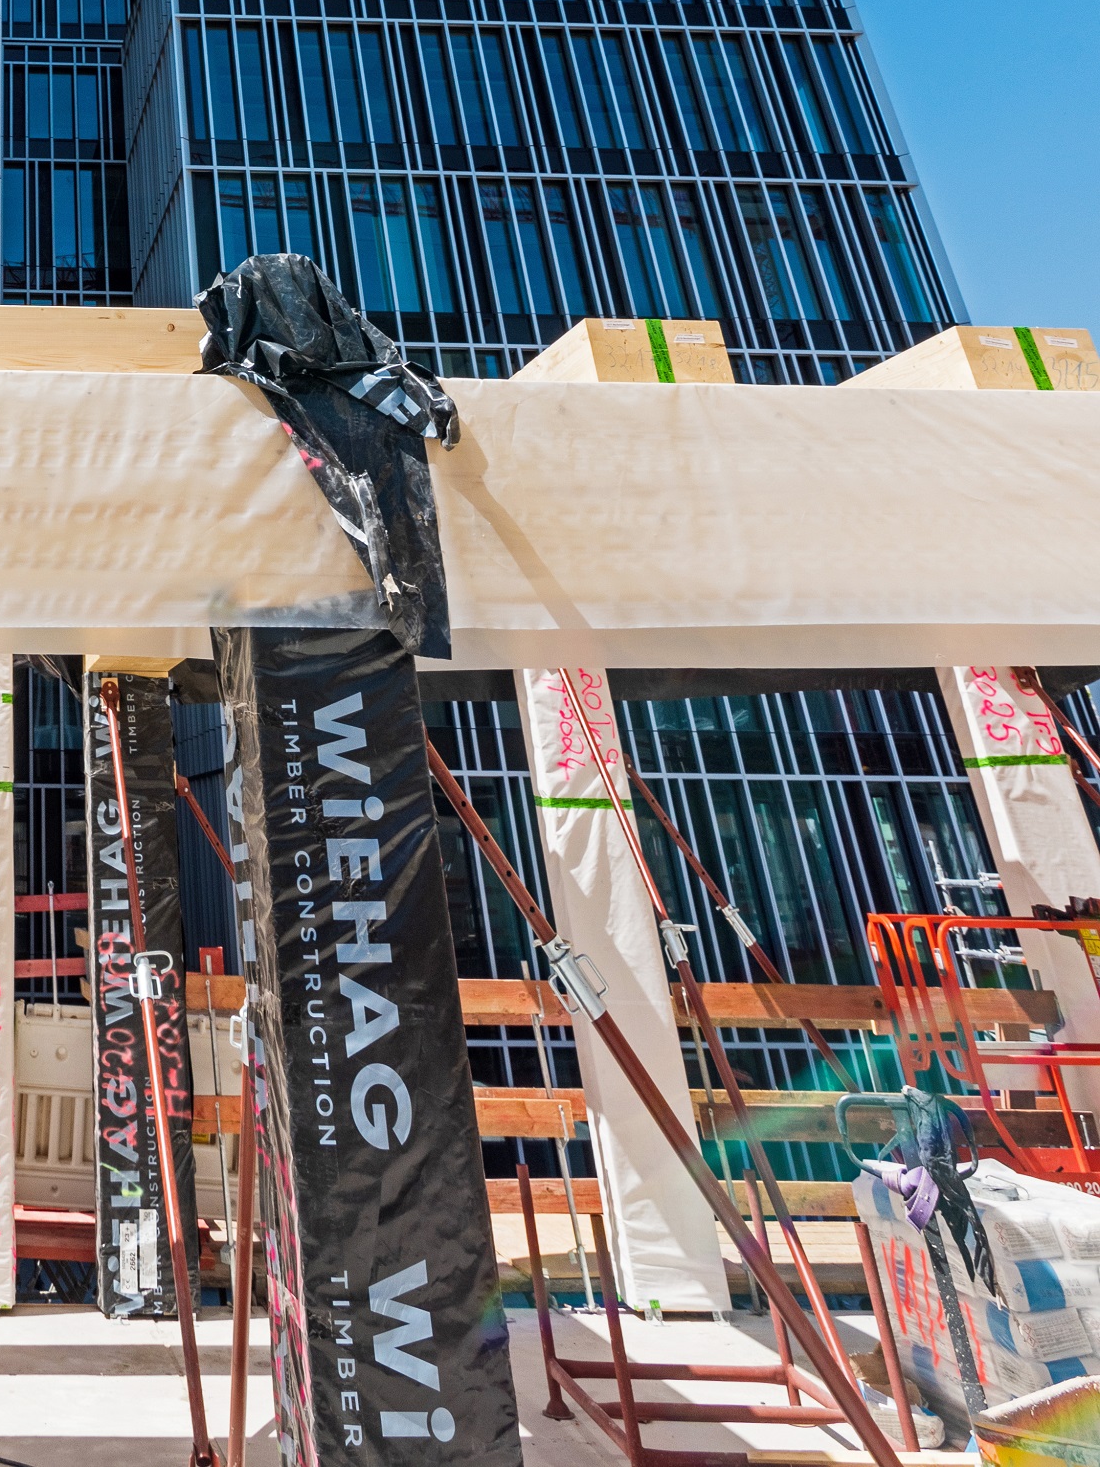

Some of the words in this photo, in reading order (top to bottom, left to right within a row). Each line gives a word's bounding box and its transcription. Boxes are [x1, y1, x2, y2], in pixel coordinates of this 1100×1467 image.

[126, 692, 138, 755] TIMBER
[280, 699, 307, 824] TIMBER
[294, 850, 337, 1147] CONSTRUCTION
[330, 1270, 364, 1447] TIMBER
